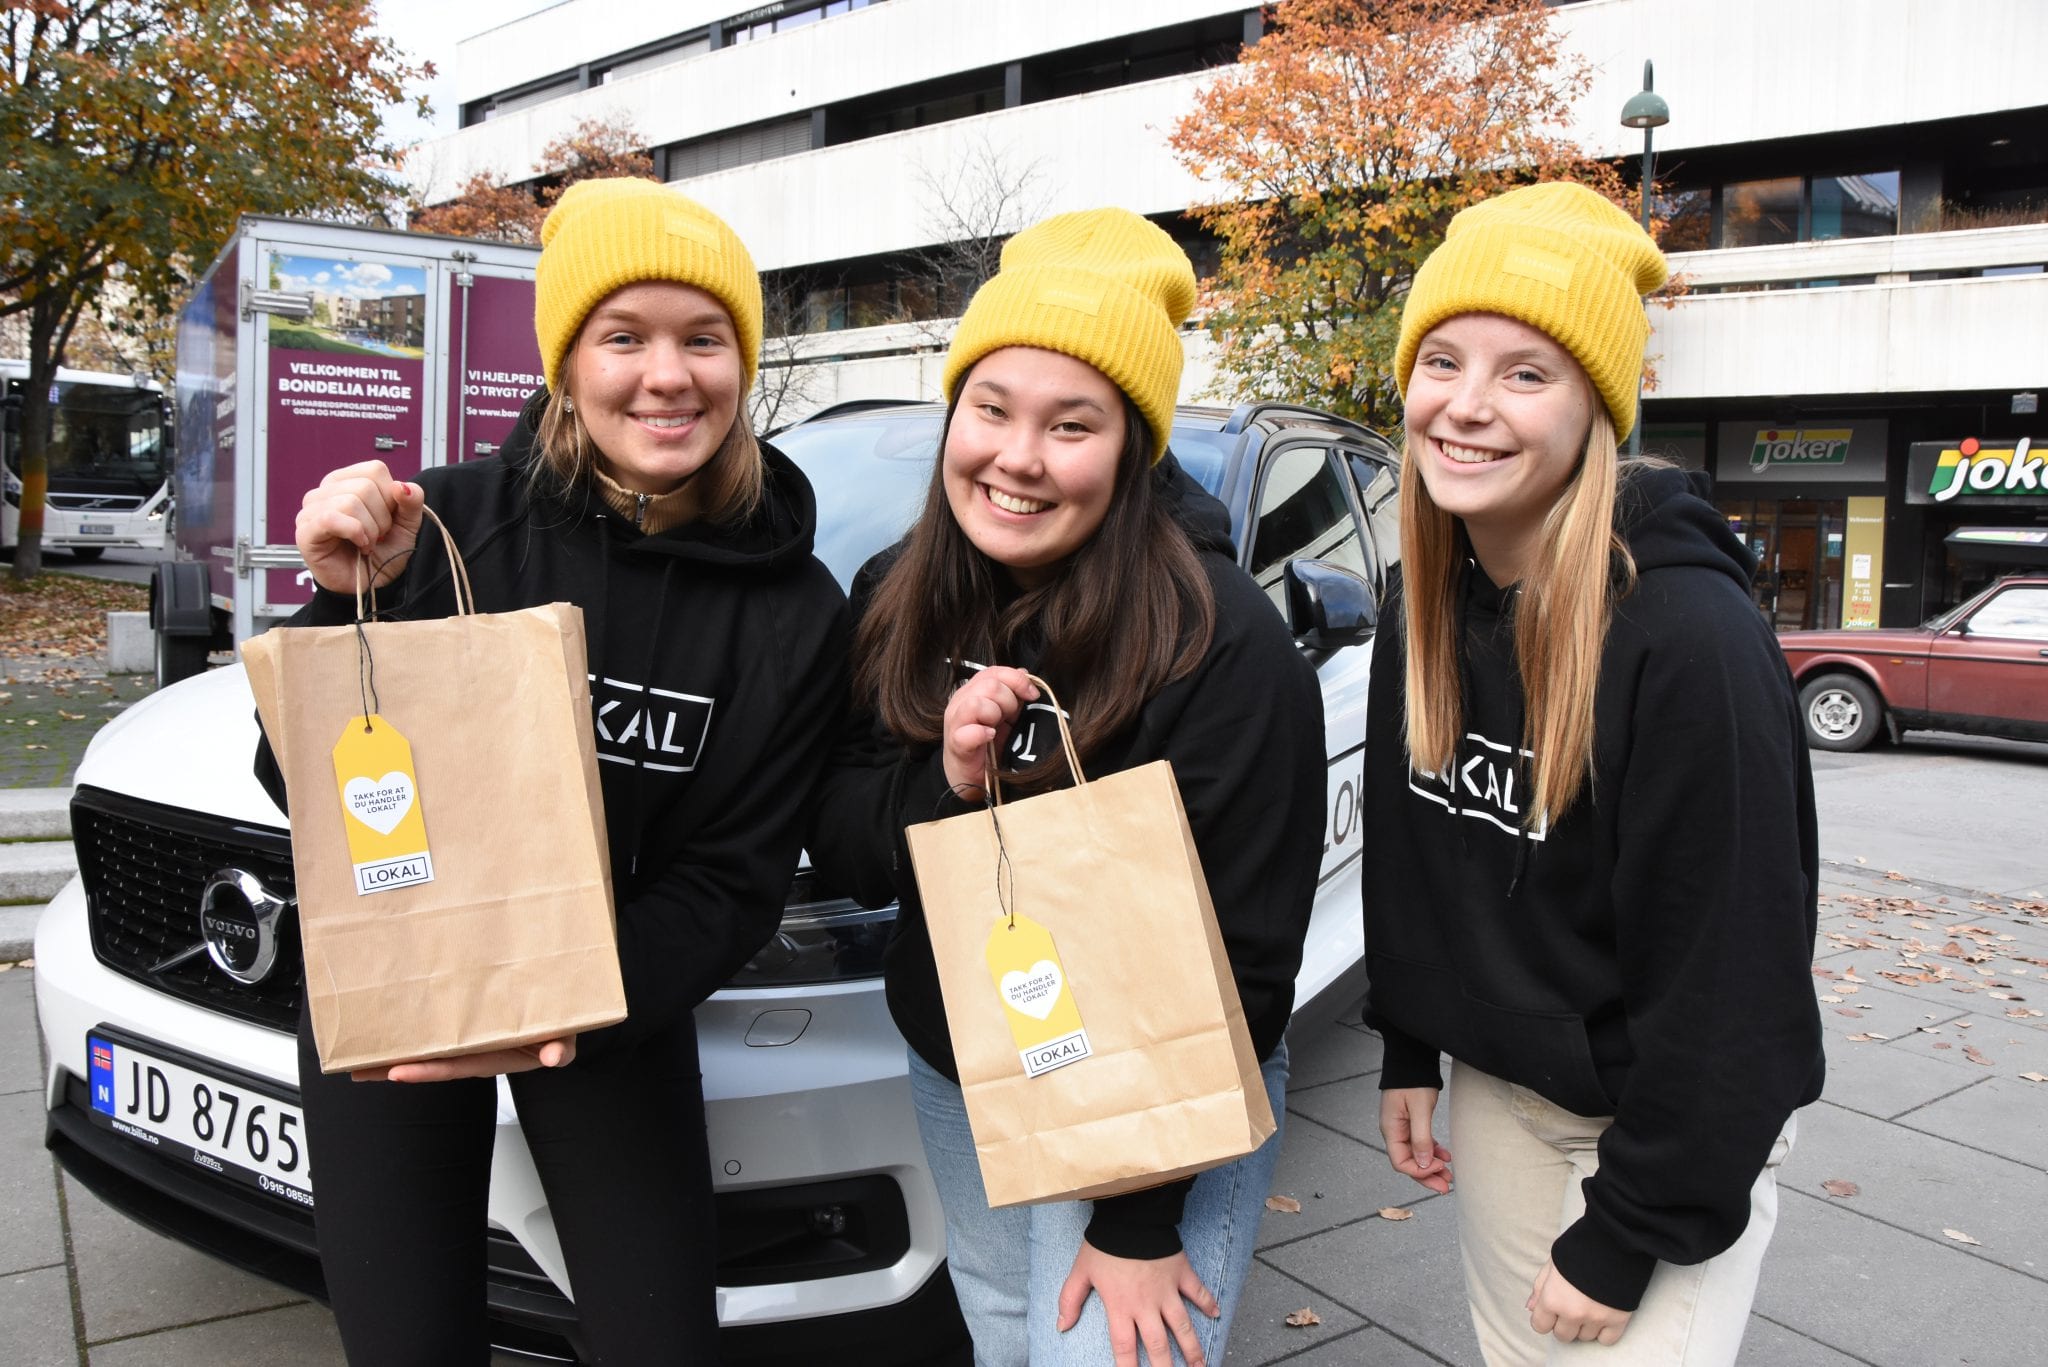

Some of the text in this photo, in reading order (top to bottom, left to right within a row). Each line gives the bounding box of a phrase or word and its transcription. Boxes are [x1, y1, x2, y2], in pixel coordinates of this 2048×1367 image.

[290, 362, 401, 381] VELKOMMEN TIL
[468, 370, 481, 381] VI
[482, 371, 534, 385] HJELPER
[279, 378, 412, 399] BONDELIA HAGE
[481, 385, 519, 398] TRYGT
[281, 398, 408, 413] ET SAMARBEIDSPROSJEKT MELLOM
[317, 409, 329, 417] OG
[361, 412, 397, 420] EIENDOM
[466, 406, 478, 415] Se
[1752, 430, 1843, 474] joker
[353, 786, 405, 801] TAKK FOR AT
[354, 794, 406, 809] DU HANDLER
[367, 803, 397, 814] LOKALT
[368, 863, 422, 884] LOKAL
[205, 916, 256, 939] VOLVO
[1009, 973, 1054, 994] TAKK FOR AT
[1011, 979, 1056, 1001] DU HANDLER
[1022, 989, 1049, 1004] LOKALT
[1033, 1042, 1080, 1067] LOKAL
[99, 1084, 109, 1103] N
[127, 1060, 312, 1180] JD 8765
[111, 1119, 159, 1145] www.bilia.no
[269, 1181, 285, 1195] 915
